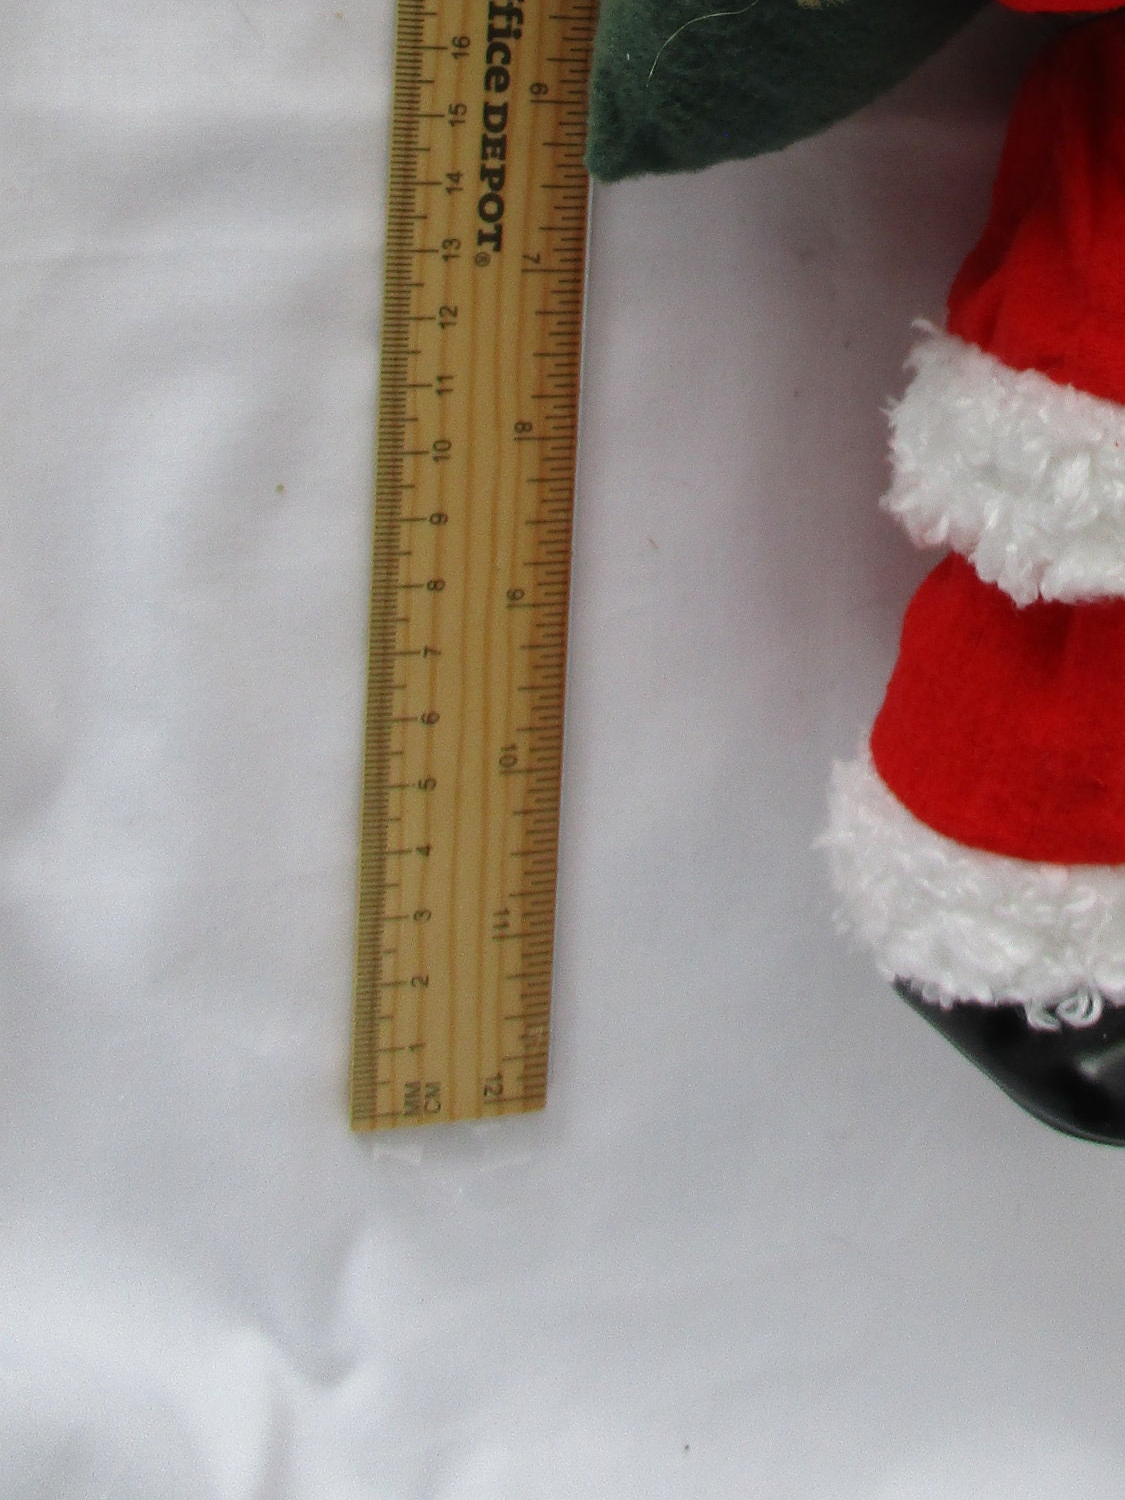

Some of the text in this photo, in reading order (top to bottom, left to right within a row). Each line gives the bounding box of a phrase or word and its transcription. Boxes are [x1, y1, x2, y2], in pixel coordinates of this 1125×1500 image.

[452, 36, 471, 60] 16
[448, 103, 467, 127] 15
[446, 170, 464, 194] 14
[477, 101, 508, 253] DEPOT
[441, 238, 461, 263] 13
[523, 253, 541, 265] 7
[439, 305, 459, 329] 12
[435, 375, 454, 396] 11
[514, 420, 534, 434] 8
[433, 439, 452, 463] 10
[429, 512, 448, 526] 9
[426, 579, 446, 592] 8
[506, 588, 525, 601] 9
[422, 645, 441, 658] 7
[420, 712, 440, 726] 6
[499, 743, 518, 768] 10
[417, 777, 437, 792] 5
[416, 843, 432, 857] 4
[413, 908, 432, 921] 3
[493, 907, 510, 929] 11
[411, 975, 430, 988] 2
[484, 1072, 504, 1097] 12
[424, 1081, 441, 1114] CM
